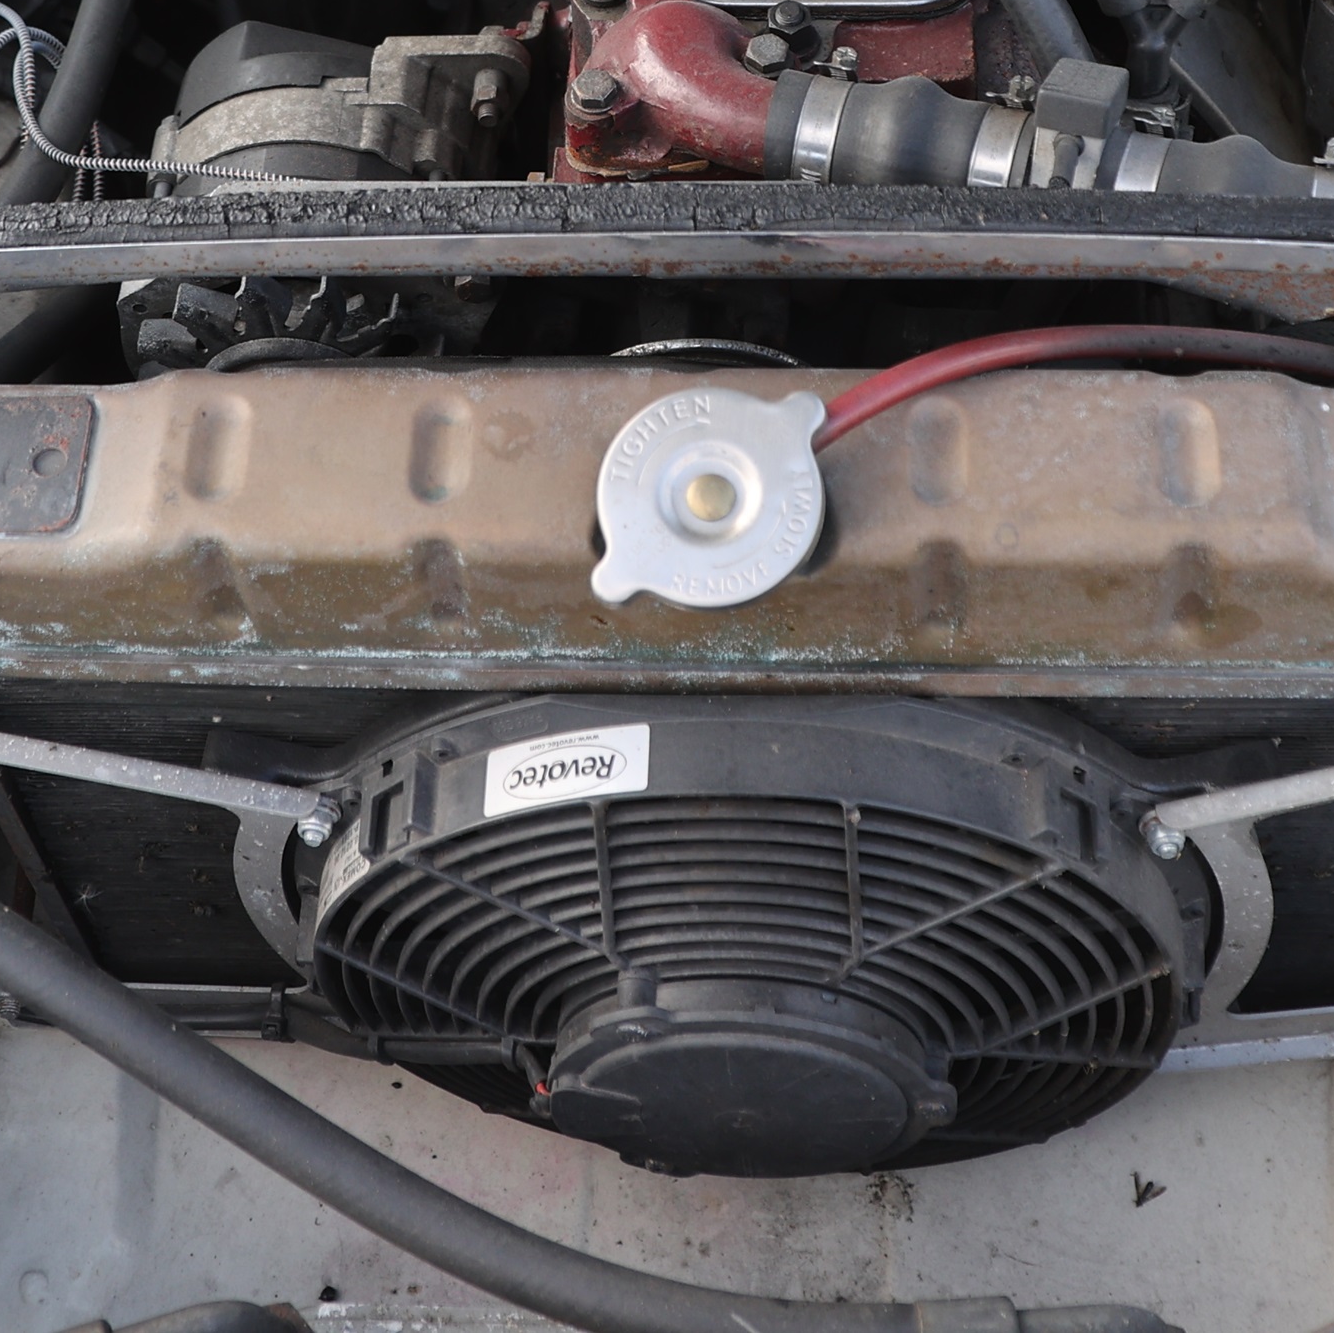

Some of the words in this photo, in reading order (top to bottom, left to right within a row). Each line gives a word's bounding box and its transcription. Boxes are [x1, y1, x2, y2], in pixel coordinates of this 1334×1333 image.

[609, 394, 711, 482] TIGHTEN
[670, 562, 770, 598] REMOVE
[529, 734, 600, 752] www.revotec.com
[509, 754, 616, 791] Revotec
